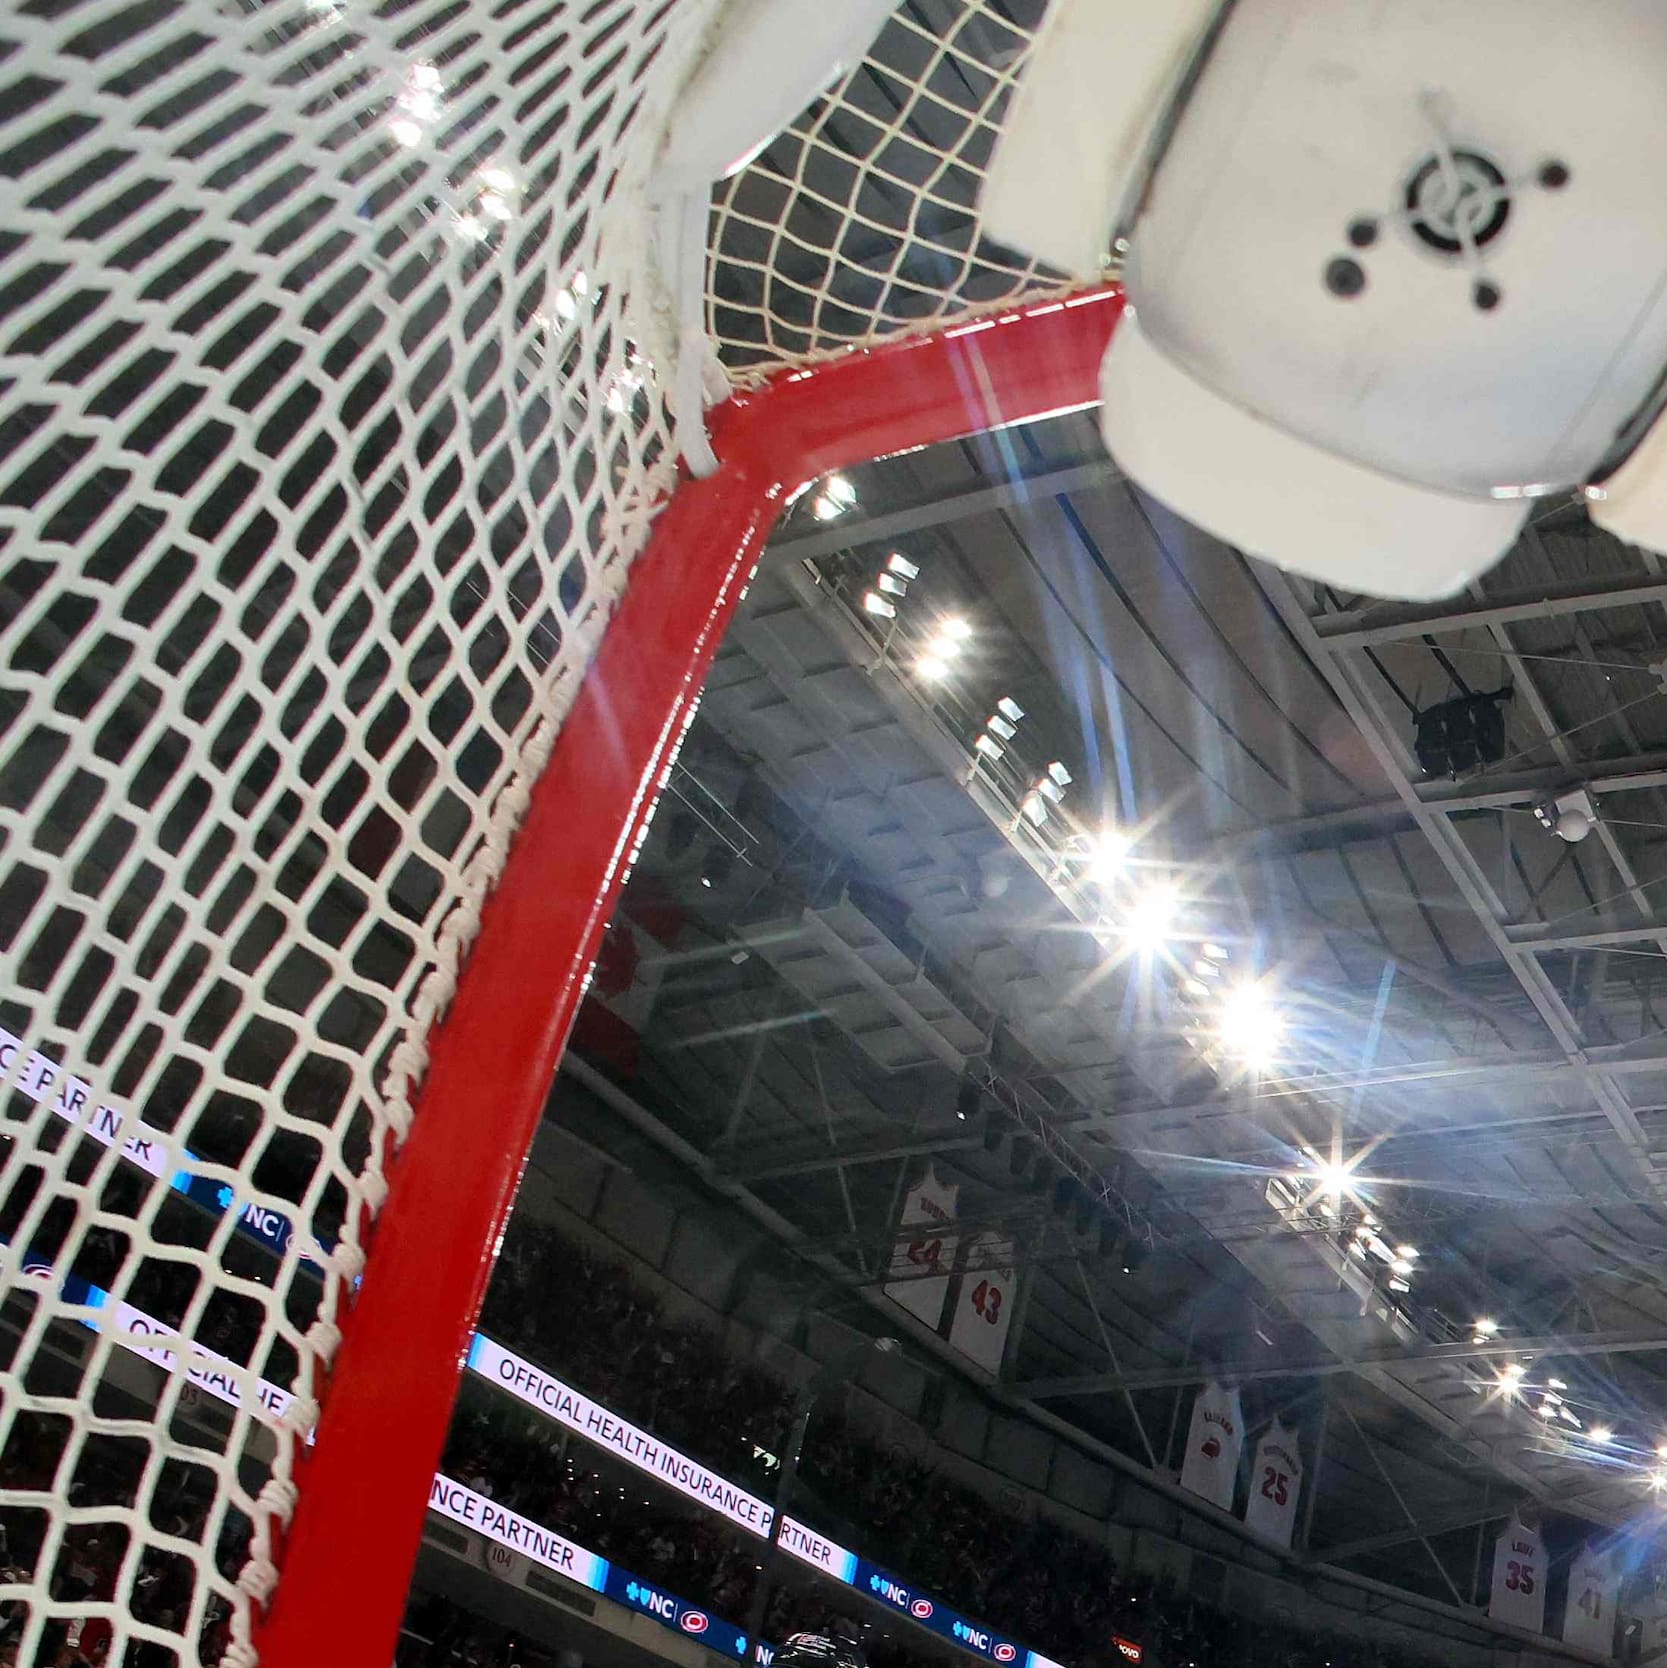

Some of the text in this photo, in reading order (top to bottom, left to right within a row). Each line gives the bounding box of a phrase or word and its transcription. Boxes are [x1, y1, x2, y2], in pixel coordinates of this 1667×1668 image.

[972, 1280, 1002, 1325] 43
[498, 1357, 832, 1565] OFFICIAL HEALTH INSURANCE PRTNER
[1262, 1466, 1289, 1506] 25
[481, 1502, 575, 1570] PARTNER
[888, 1581, 906, 1605] NC
[1505, 1560, 1535, 1595] 35
[650, 1591, 674, 1618] NC
[969, 1625, 988, 1650] NC
